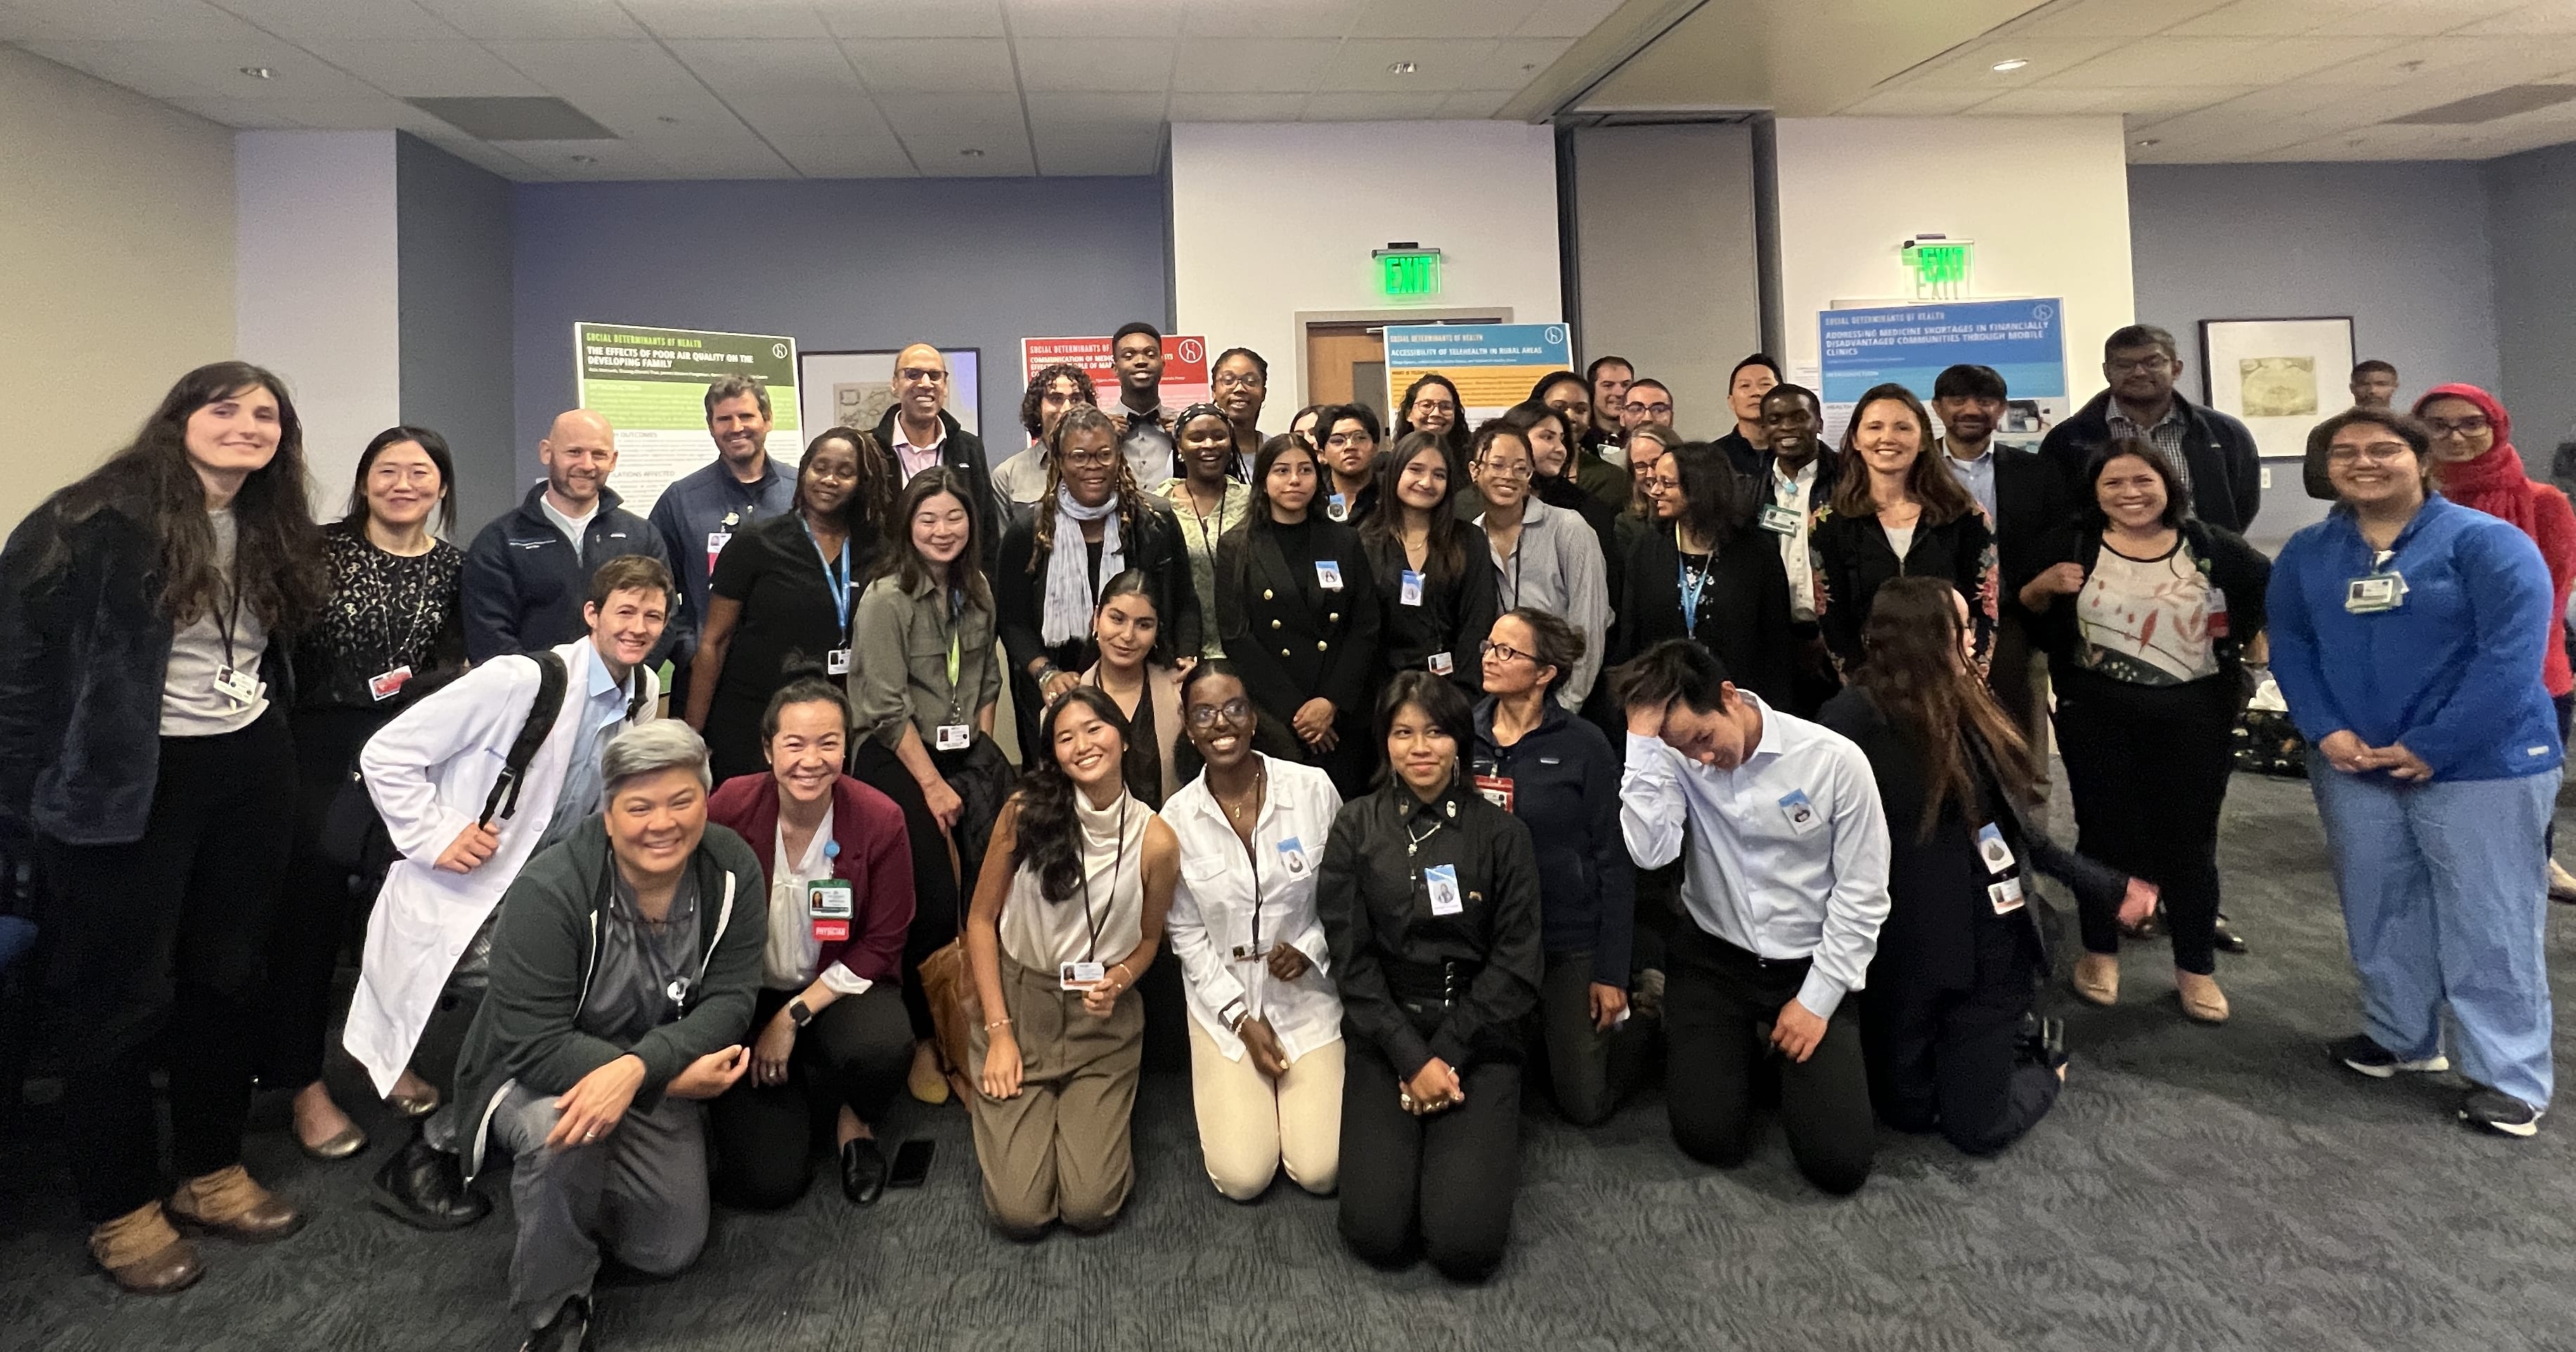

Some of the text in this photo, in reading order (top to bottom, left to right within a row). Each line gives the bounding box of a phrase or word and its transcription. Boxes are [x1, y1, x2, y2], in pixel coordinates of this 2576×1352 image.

[1922, 248, 1964, 282] EXIT
[1385, 256, 1432, 294] EXIT
[1825, 311, 1945, 326] SOCIAL DETERMINANTS OF HEALTH
[1826, 321, 2049, 339] ADDRESSING MEDICINE SHORTAGES IN FINANCIALLY
[585, 332, 702, 349] SOCIAL DETERMINANTS OF HEALTH
[1826, 330, 2043, 349] DISADVANTAGED COMMUNITIES THROUGH MOBILE
[586, 346, 755, 364] THE EFFECTS OF POOR AIR QUALITY ON THE
[1030, 343, 1110, 354] SOCIAL DETERMINANTS OF
[1391, 348, 1437, 357] ACCESSIBILITY
[1438, 348, 1447, 356] OF
[1449, 348, 1488, 356] TELEHEALTH
[1499, 346, 1521, 355] RURAL
[1521, 346, 1543, 355] AREAS
[1826, 348, 1858, 357] CLINICS
[588, 356, 673, 368] DEVELOPING FAMILY
[1030, 356, 1084, 364] COMMUNICATION
